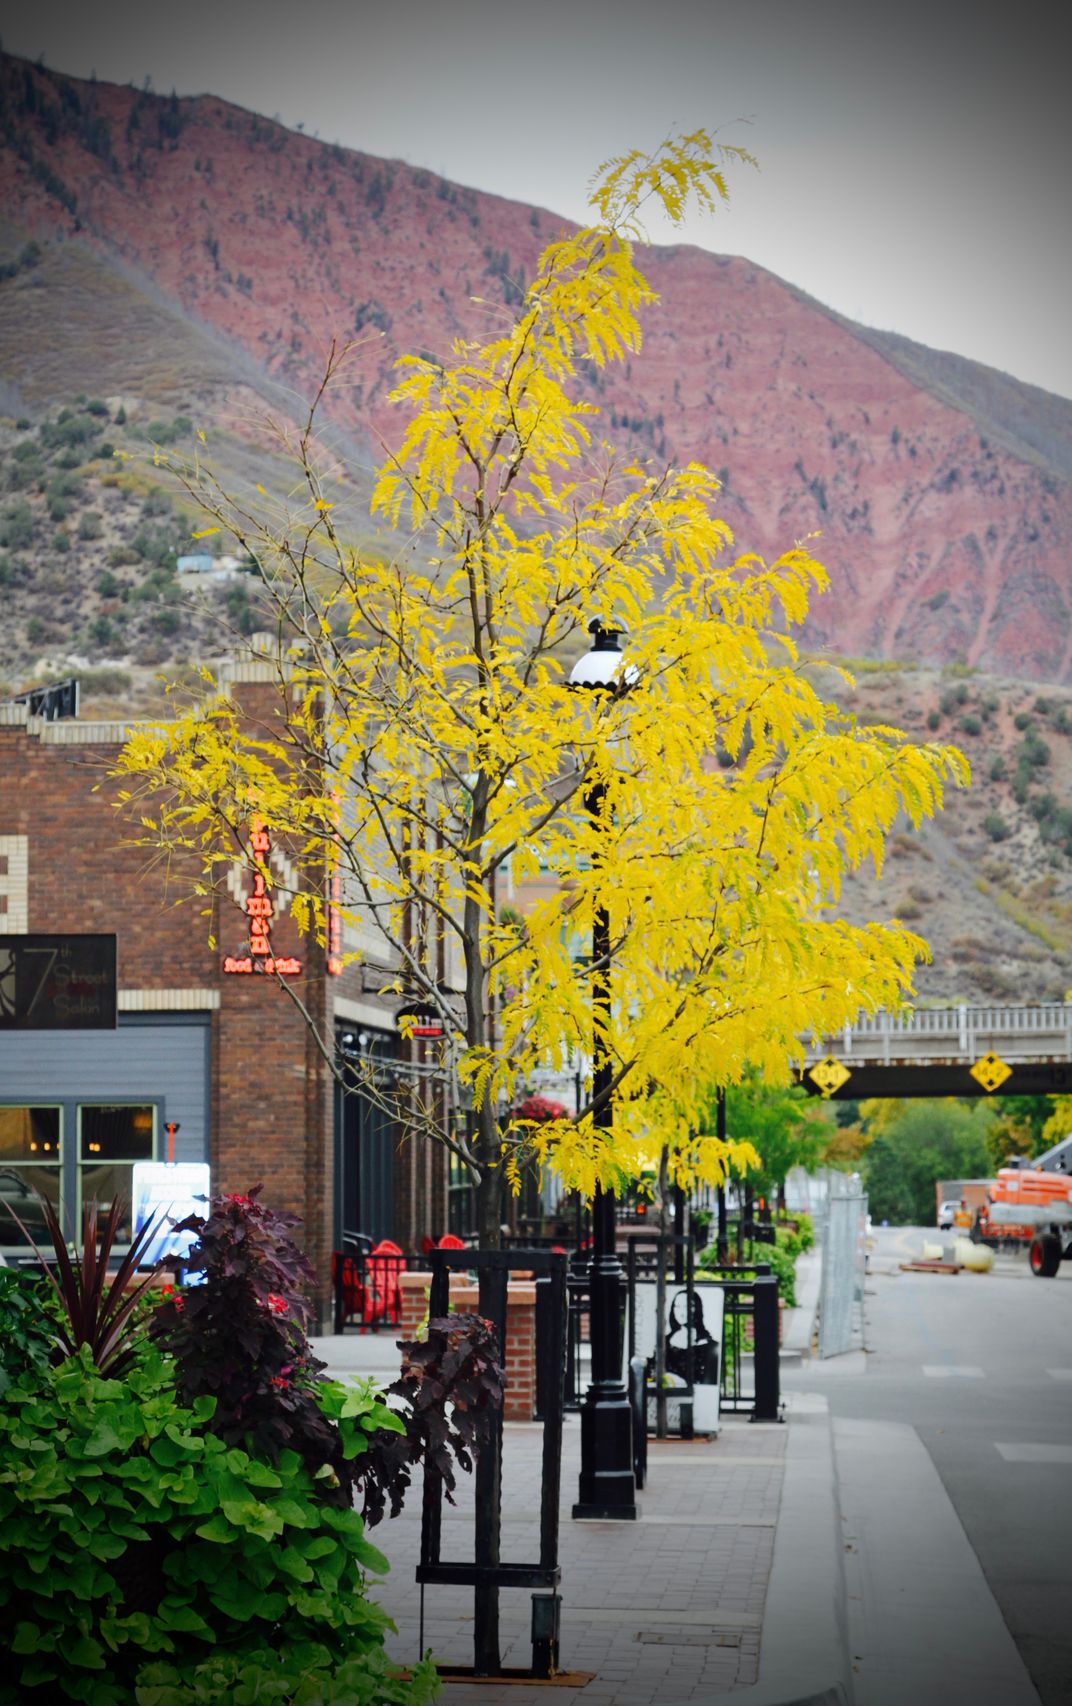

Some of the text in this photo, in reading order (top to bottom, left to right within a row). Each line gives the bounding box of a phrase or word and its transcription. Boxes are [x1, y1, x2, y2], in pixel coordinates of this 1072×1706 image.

[52, 963, 108, 987] Street
[224, 957, 252, 973] food
[52, 993, 100, 1016] Salon
